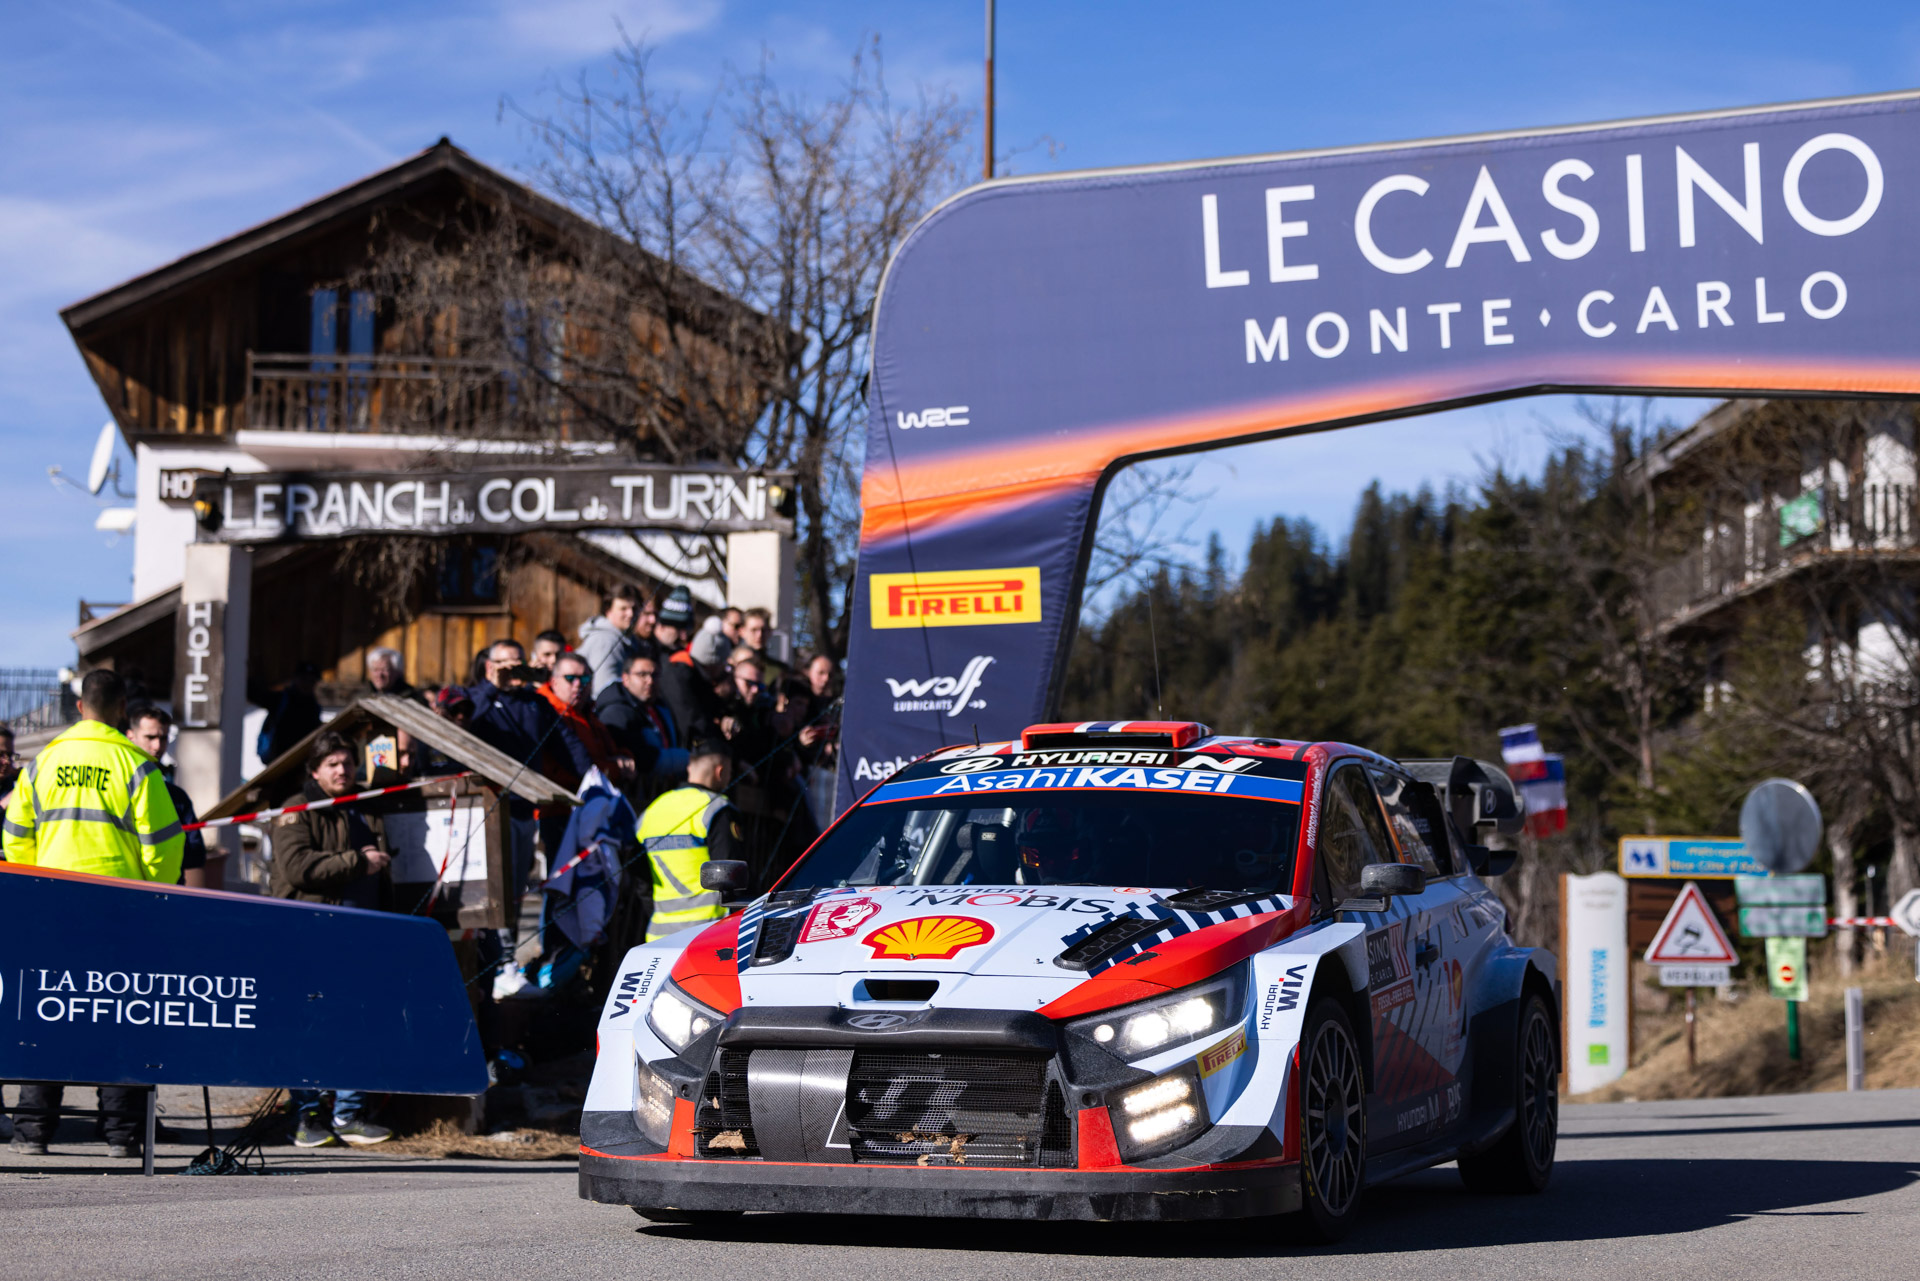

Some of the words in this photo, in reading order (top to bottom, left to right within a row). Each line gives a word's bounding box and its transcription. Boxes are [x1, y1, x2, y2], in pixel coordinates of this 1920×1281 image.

[1202, 184, 1319, 289] LE
[1354, 132, 1885, 275] CASINO
[1244, 298, 1515, 364] MONTE
[1576, 270, 1848, 339] CARLO
[897, 405, 971, 430] WRC
[160, 472, 198, 499] HO
[478, 476, 581, 523] COL
[888, 579, 1025, 617] PIRELLI
[184, 602, 212, 727] HOTEL
[1011, 752, 1169, 767] HYUNDAI
[907, 893, 1115, 914] MOBIS
[38, 969, 78, 992] LA
[85, 970, 258, 1004] BOUTIQUE
[638, 957, 662, 997] HYUNDAI
[37, 996, 256, 1029] OFFICIELLE
[1260, 984, 1279, 1030] HYUNDAI
[1202, 1031, 1245, 1073] PIRELLI
